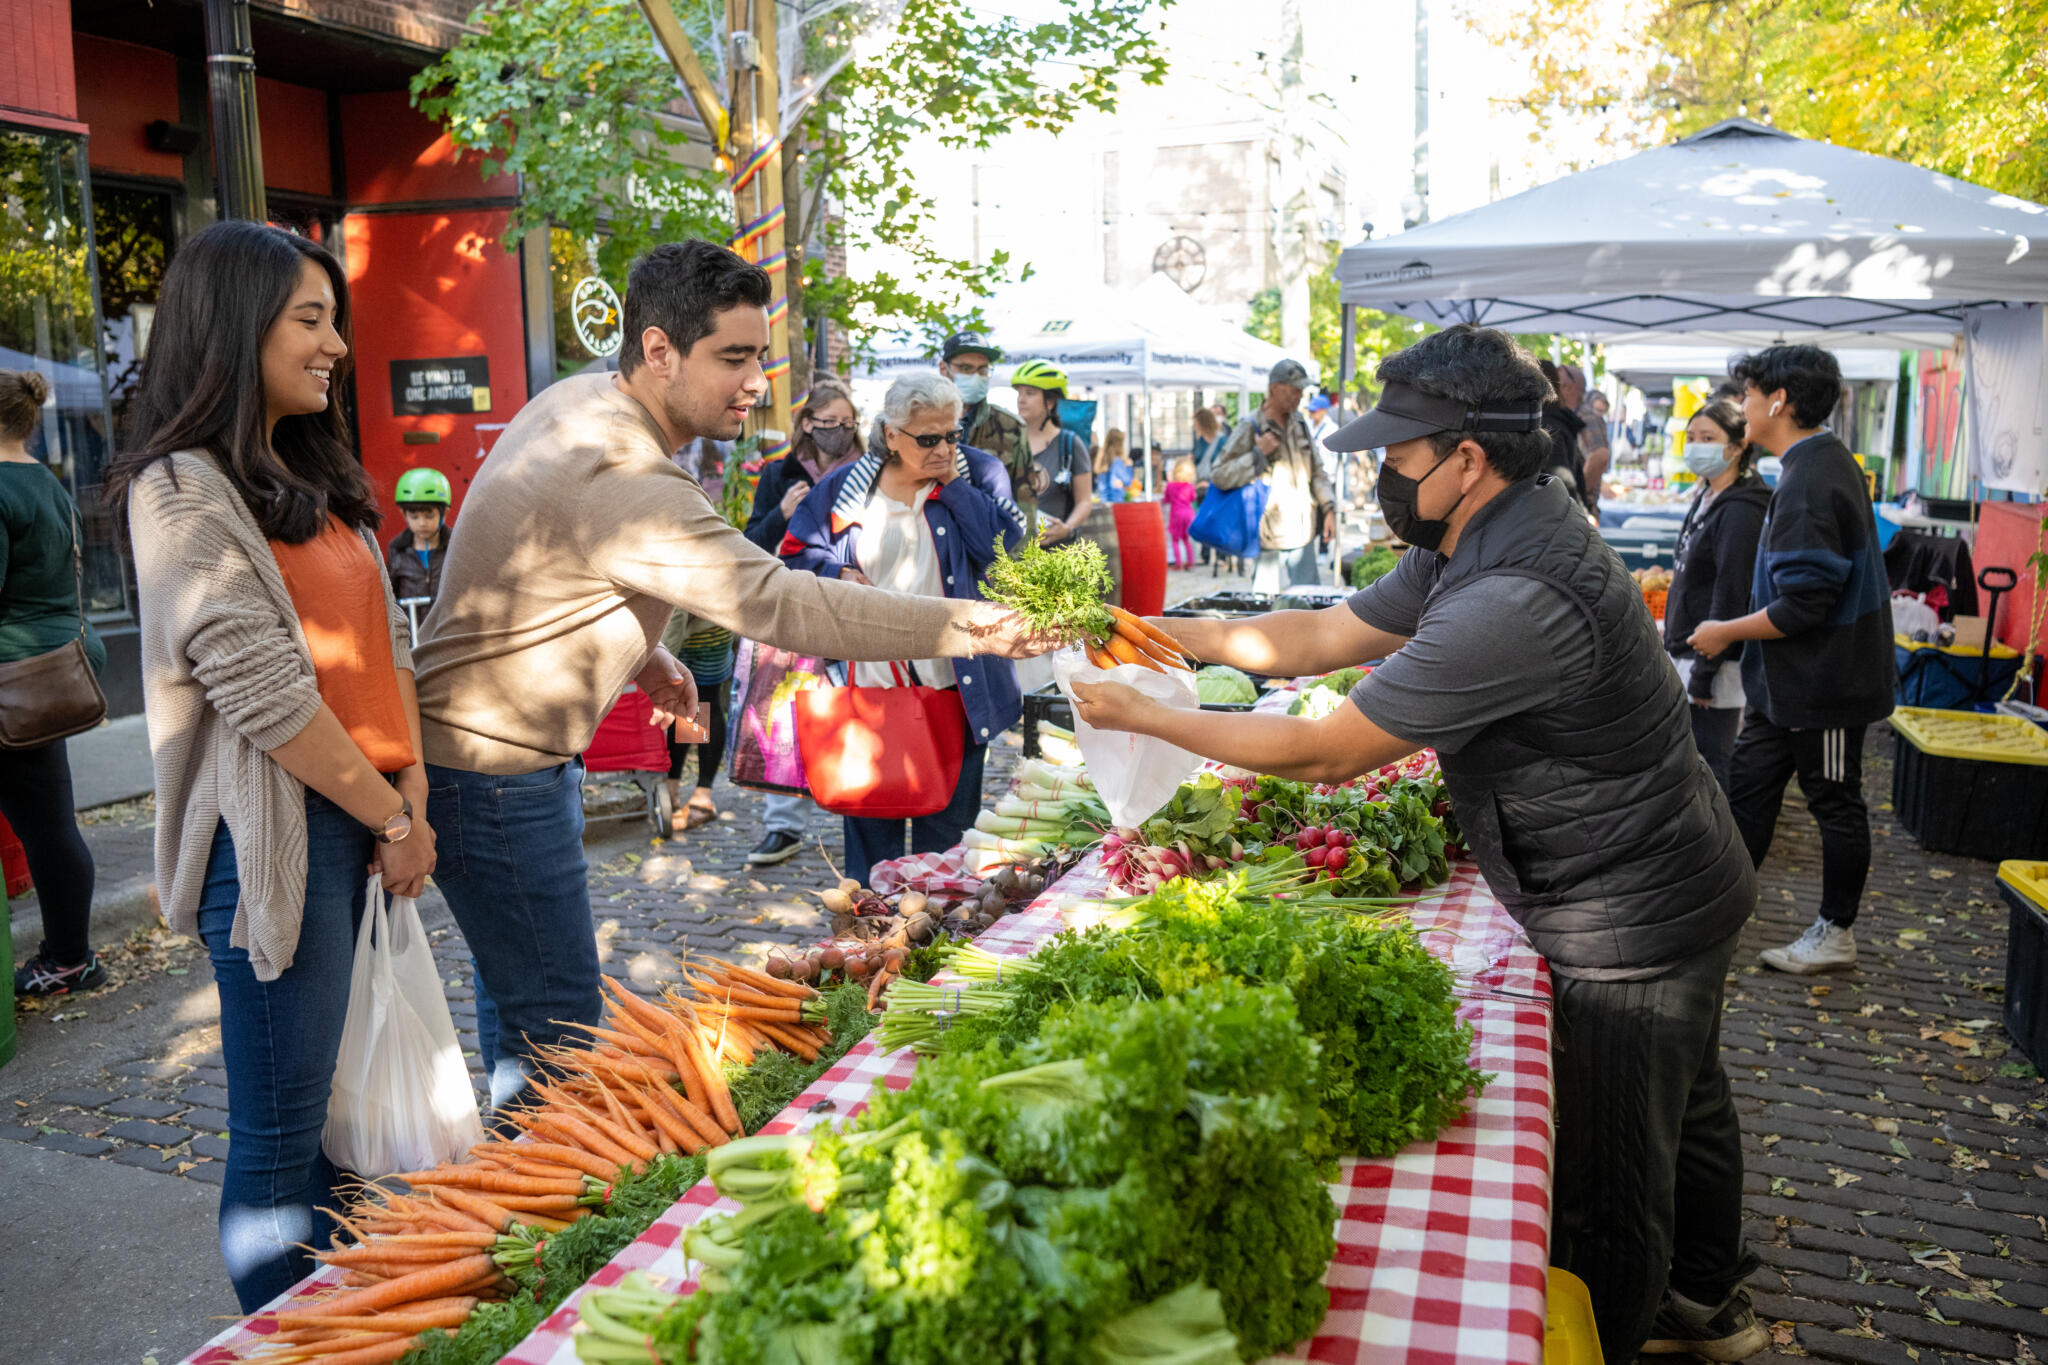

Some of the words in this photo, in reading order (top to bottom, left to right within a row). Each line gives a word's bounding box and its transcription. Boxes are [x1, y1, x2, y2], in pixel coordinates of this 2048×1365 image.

[1059, 350, 1133, 365] Community
[451, 368, 466, 383] TO
[405, 386, 426, 402] ONE
[427, 383, 473, 400] ANOTHER
